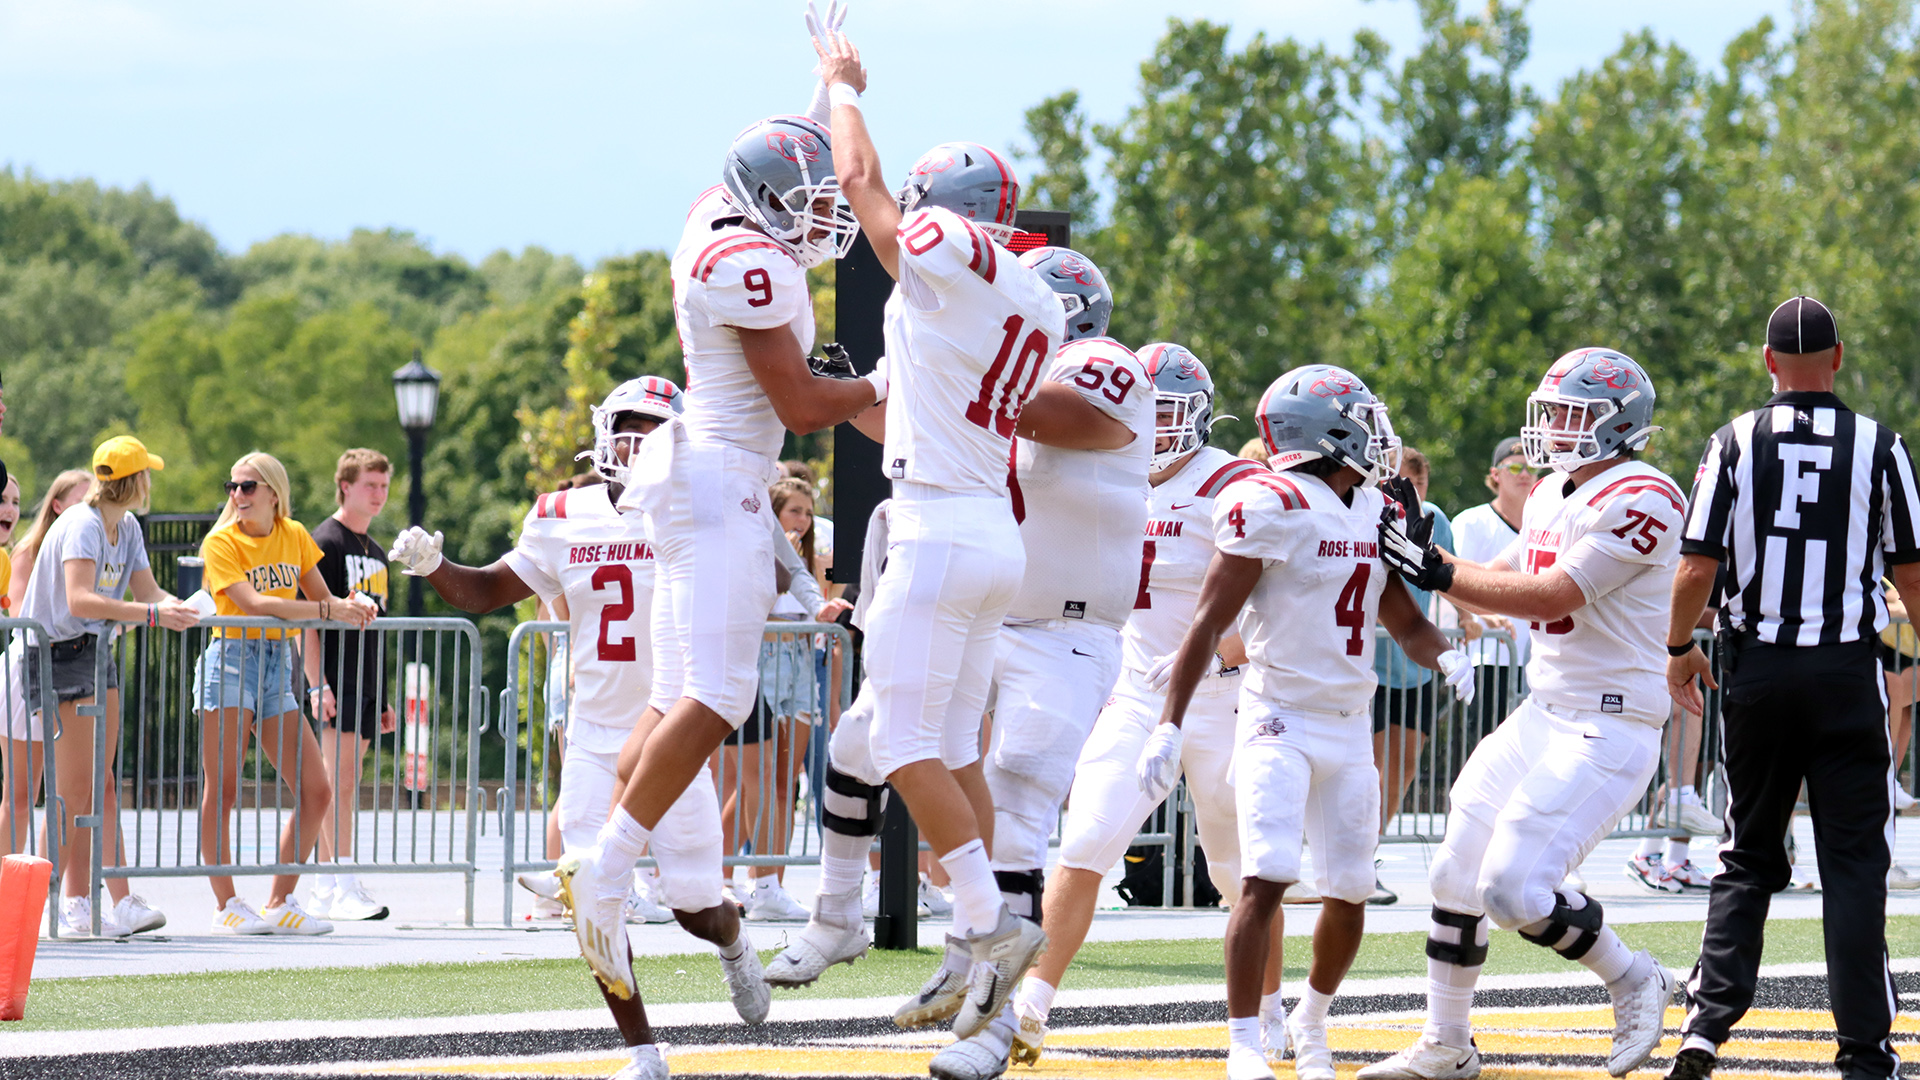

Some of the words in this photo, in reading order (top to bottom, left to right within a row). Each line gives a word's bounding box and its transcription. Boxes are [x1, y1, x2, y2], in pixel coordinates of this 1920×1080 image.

[743, 267, 773, 308] 9
[965, 314, 1049, 441] 10
[1074, 356, 1136, 405] 59
[1774, 442, 1833, 530] F
[1228, 501, 1246, 539] 4
[1611, 508, 1669, 556] 75
[1318, 540, 1380, 558] ROSE-HULM
[591, 563, 637, 662] 2
[1069, 602, 1080, 610] XL
[1334, 562, 1371, 656] 4
[1604, 695, 1621, 704] 2XL
